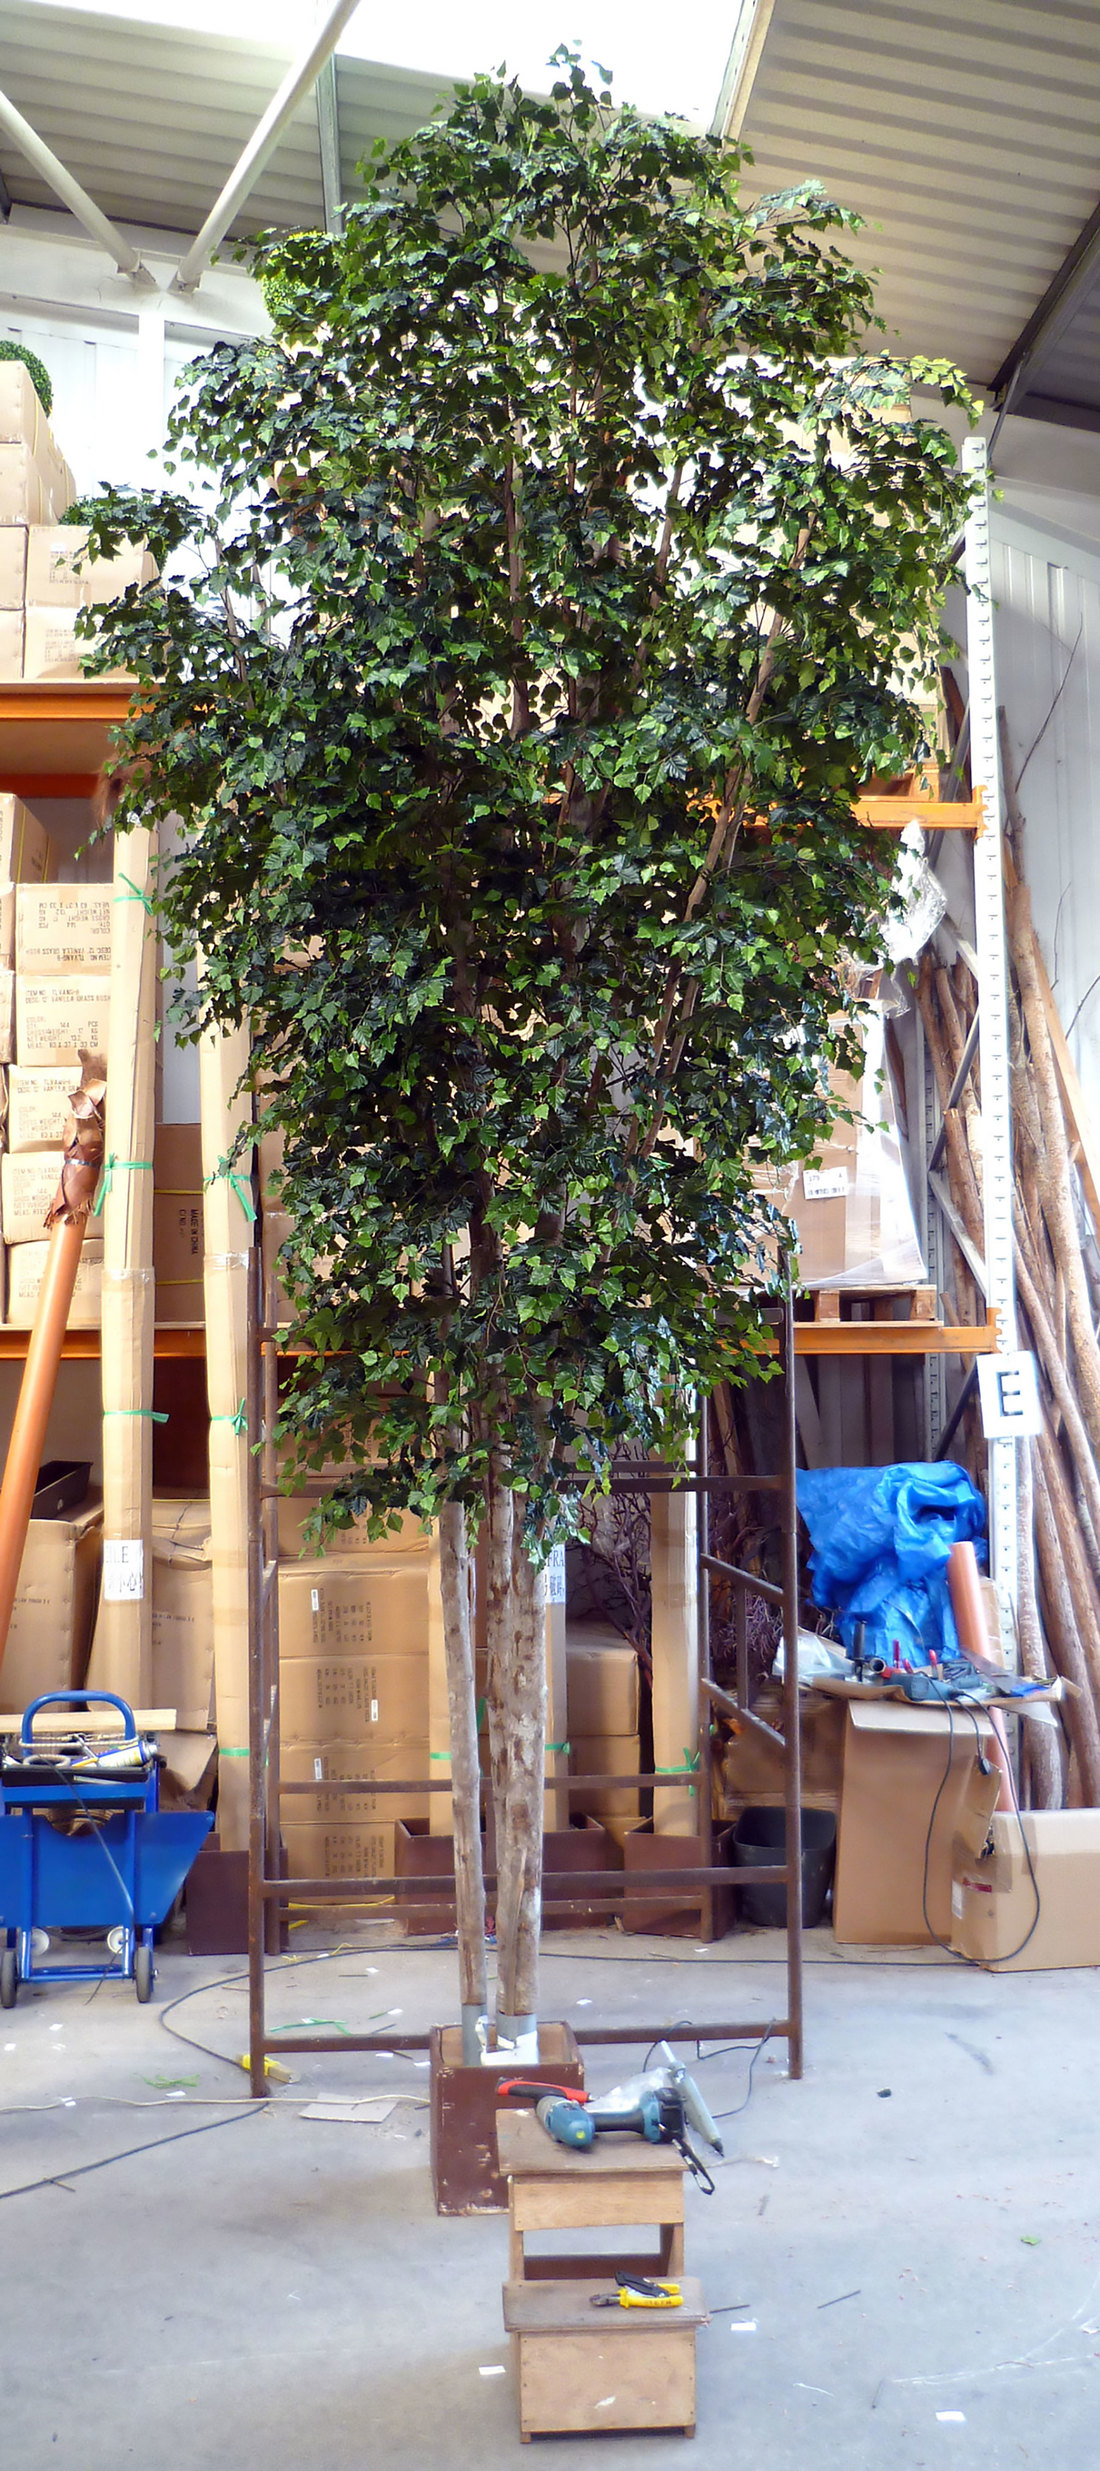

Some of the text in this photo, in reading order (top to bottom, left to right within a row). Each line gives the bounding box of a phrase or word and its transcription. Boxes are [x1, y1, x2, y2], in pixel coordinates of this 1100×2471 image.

[190, 1209, 199, 1227] MADE
[190, 1237, 199, 1255] CHINA
[995, 1370, 1024, 1417] E
